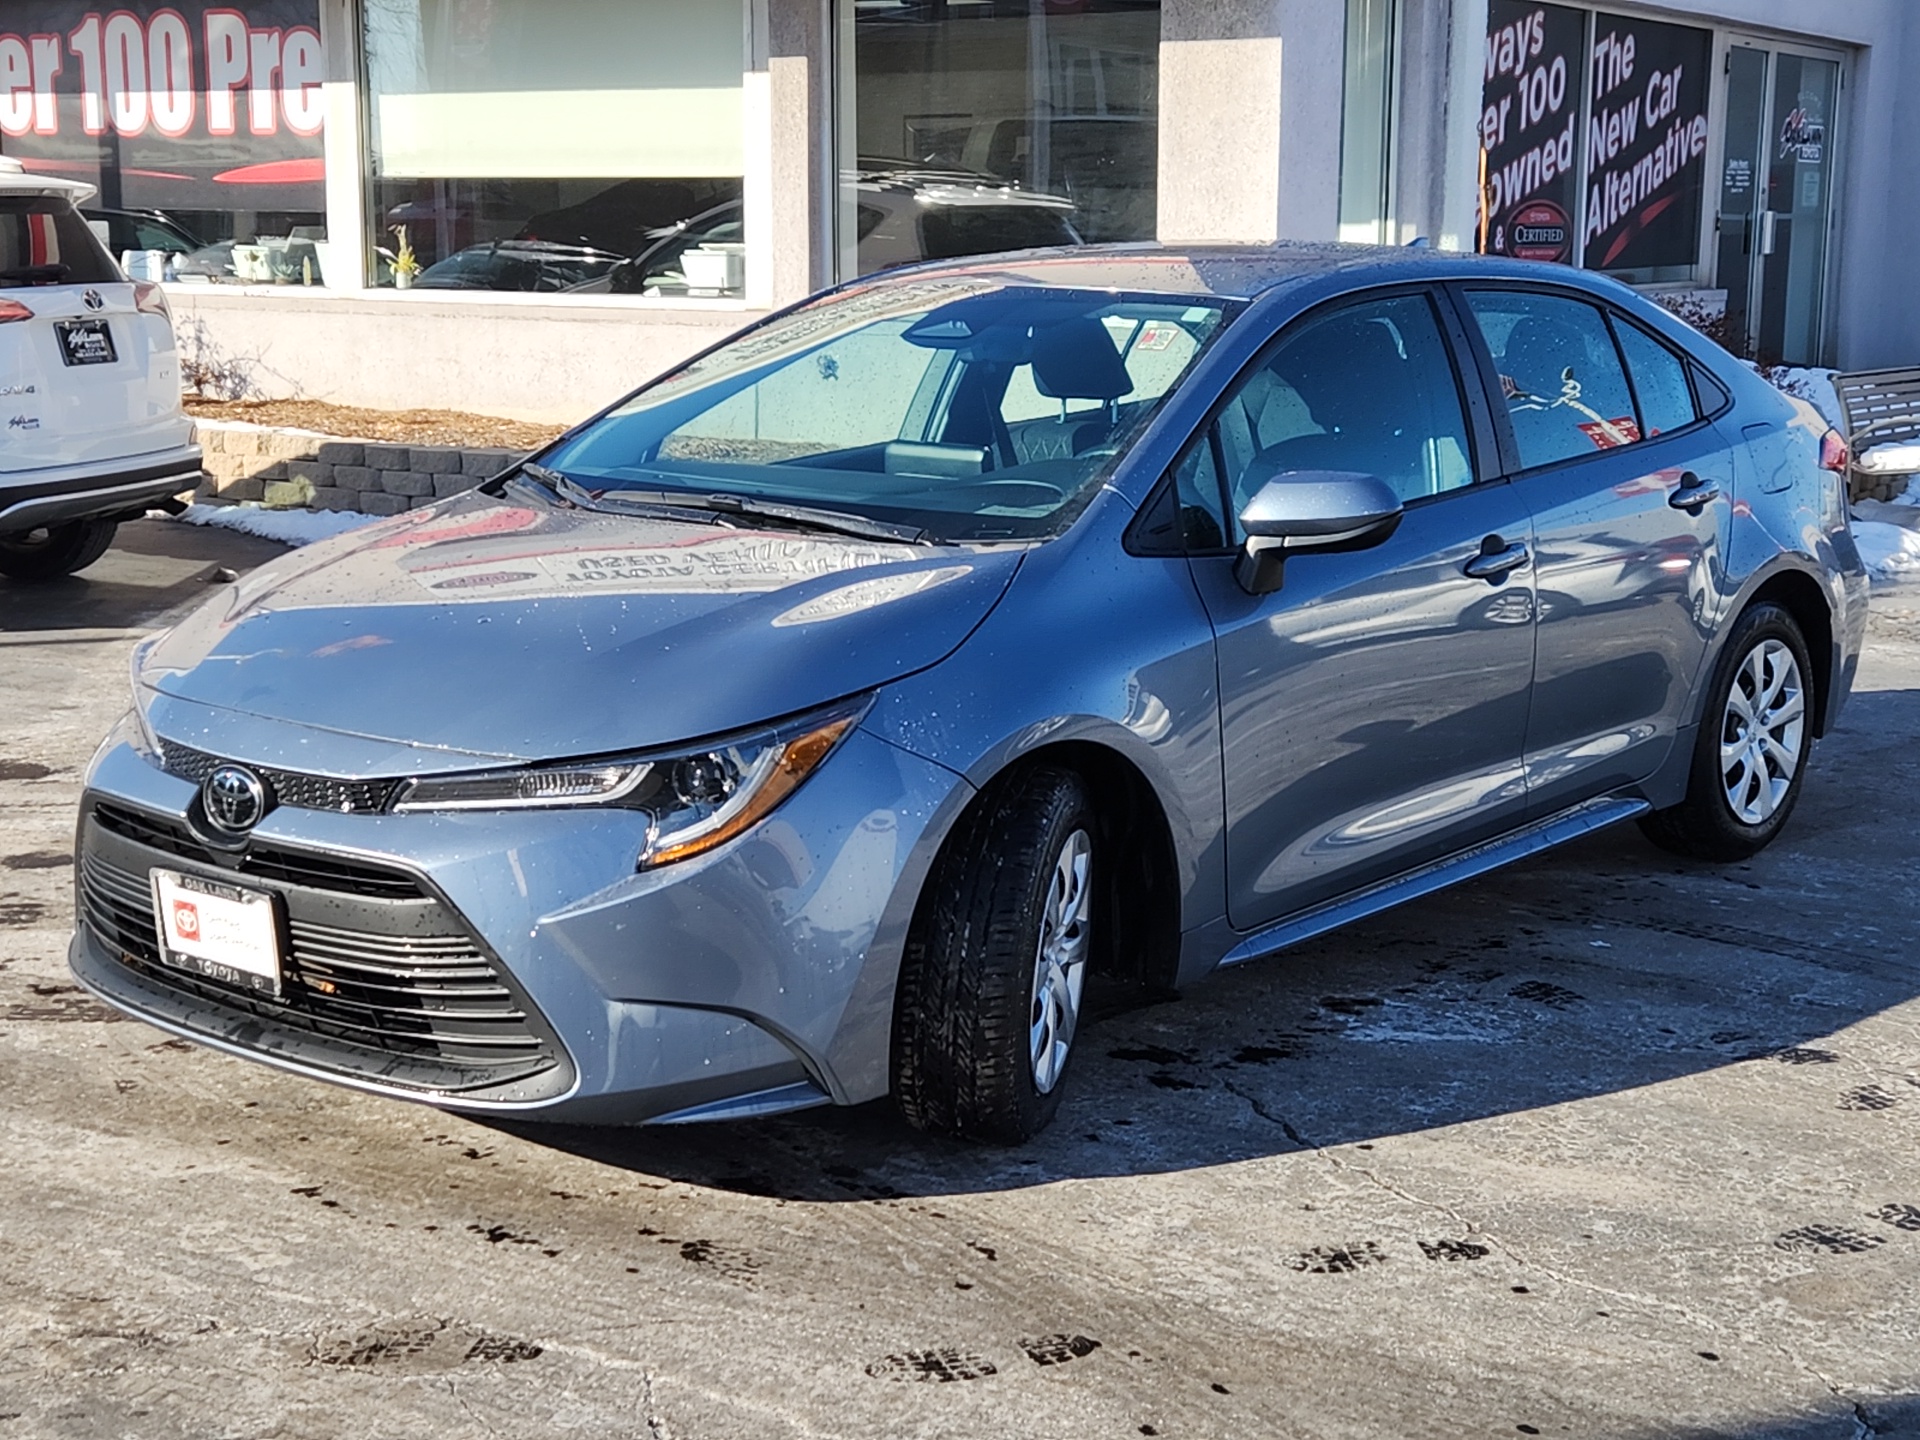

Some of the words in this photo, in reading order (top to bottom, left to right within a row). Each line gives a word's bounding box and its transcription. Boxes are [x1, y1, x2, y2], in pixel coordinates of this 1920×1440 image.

[0, 33, 62, 137] er
[67, 8, 196, 138] 100
[203, 8, 324, 137] Pre
[1519, 54, 1566, 133] 100
[1594, 30, 1636, 100] The
[1589, 96, 1641, 174] New
[1645, 63, 1682, 129] Car
[1585, 113, 1708, 247] Alternative
[1515, 225, 1564, 243] CERTIFIED
[197, 959, 240, 984] TOYOTA
